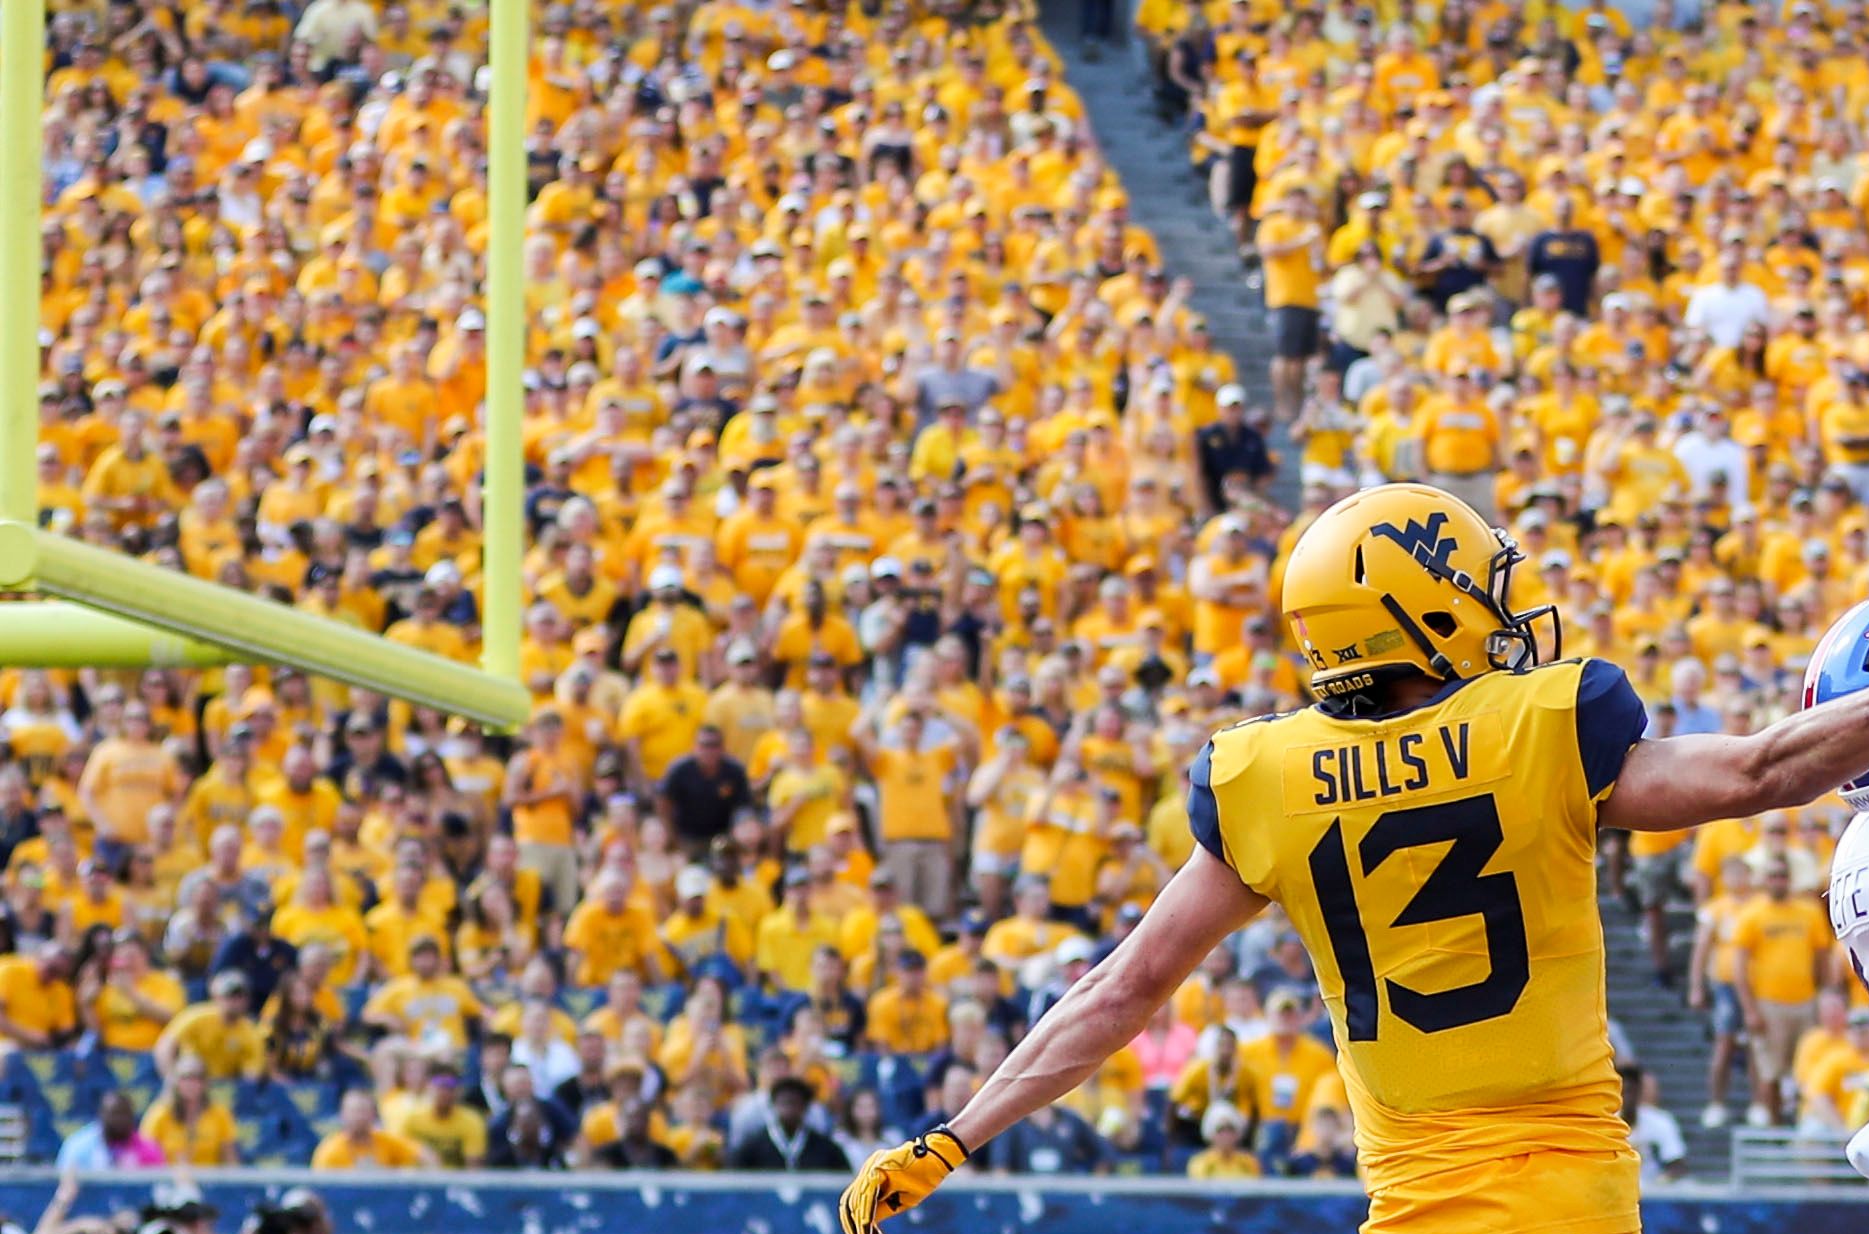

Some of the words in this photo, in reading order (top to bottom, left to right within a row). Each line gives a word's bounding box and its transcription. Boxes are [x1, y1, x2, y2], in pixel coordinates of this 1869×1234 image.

[1312, 733, 1428, 805] SILLS
[1440, 722, 1470, 780] V
[1308, 792, 1530, 1042] 13
